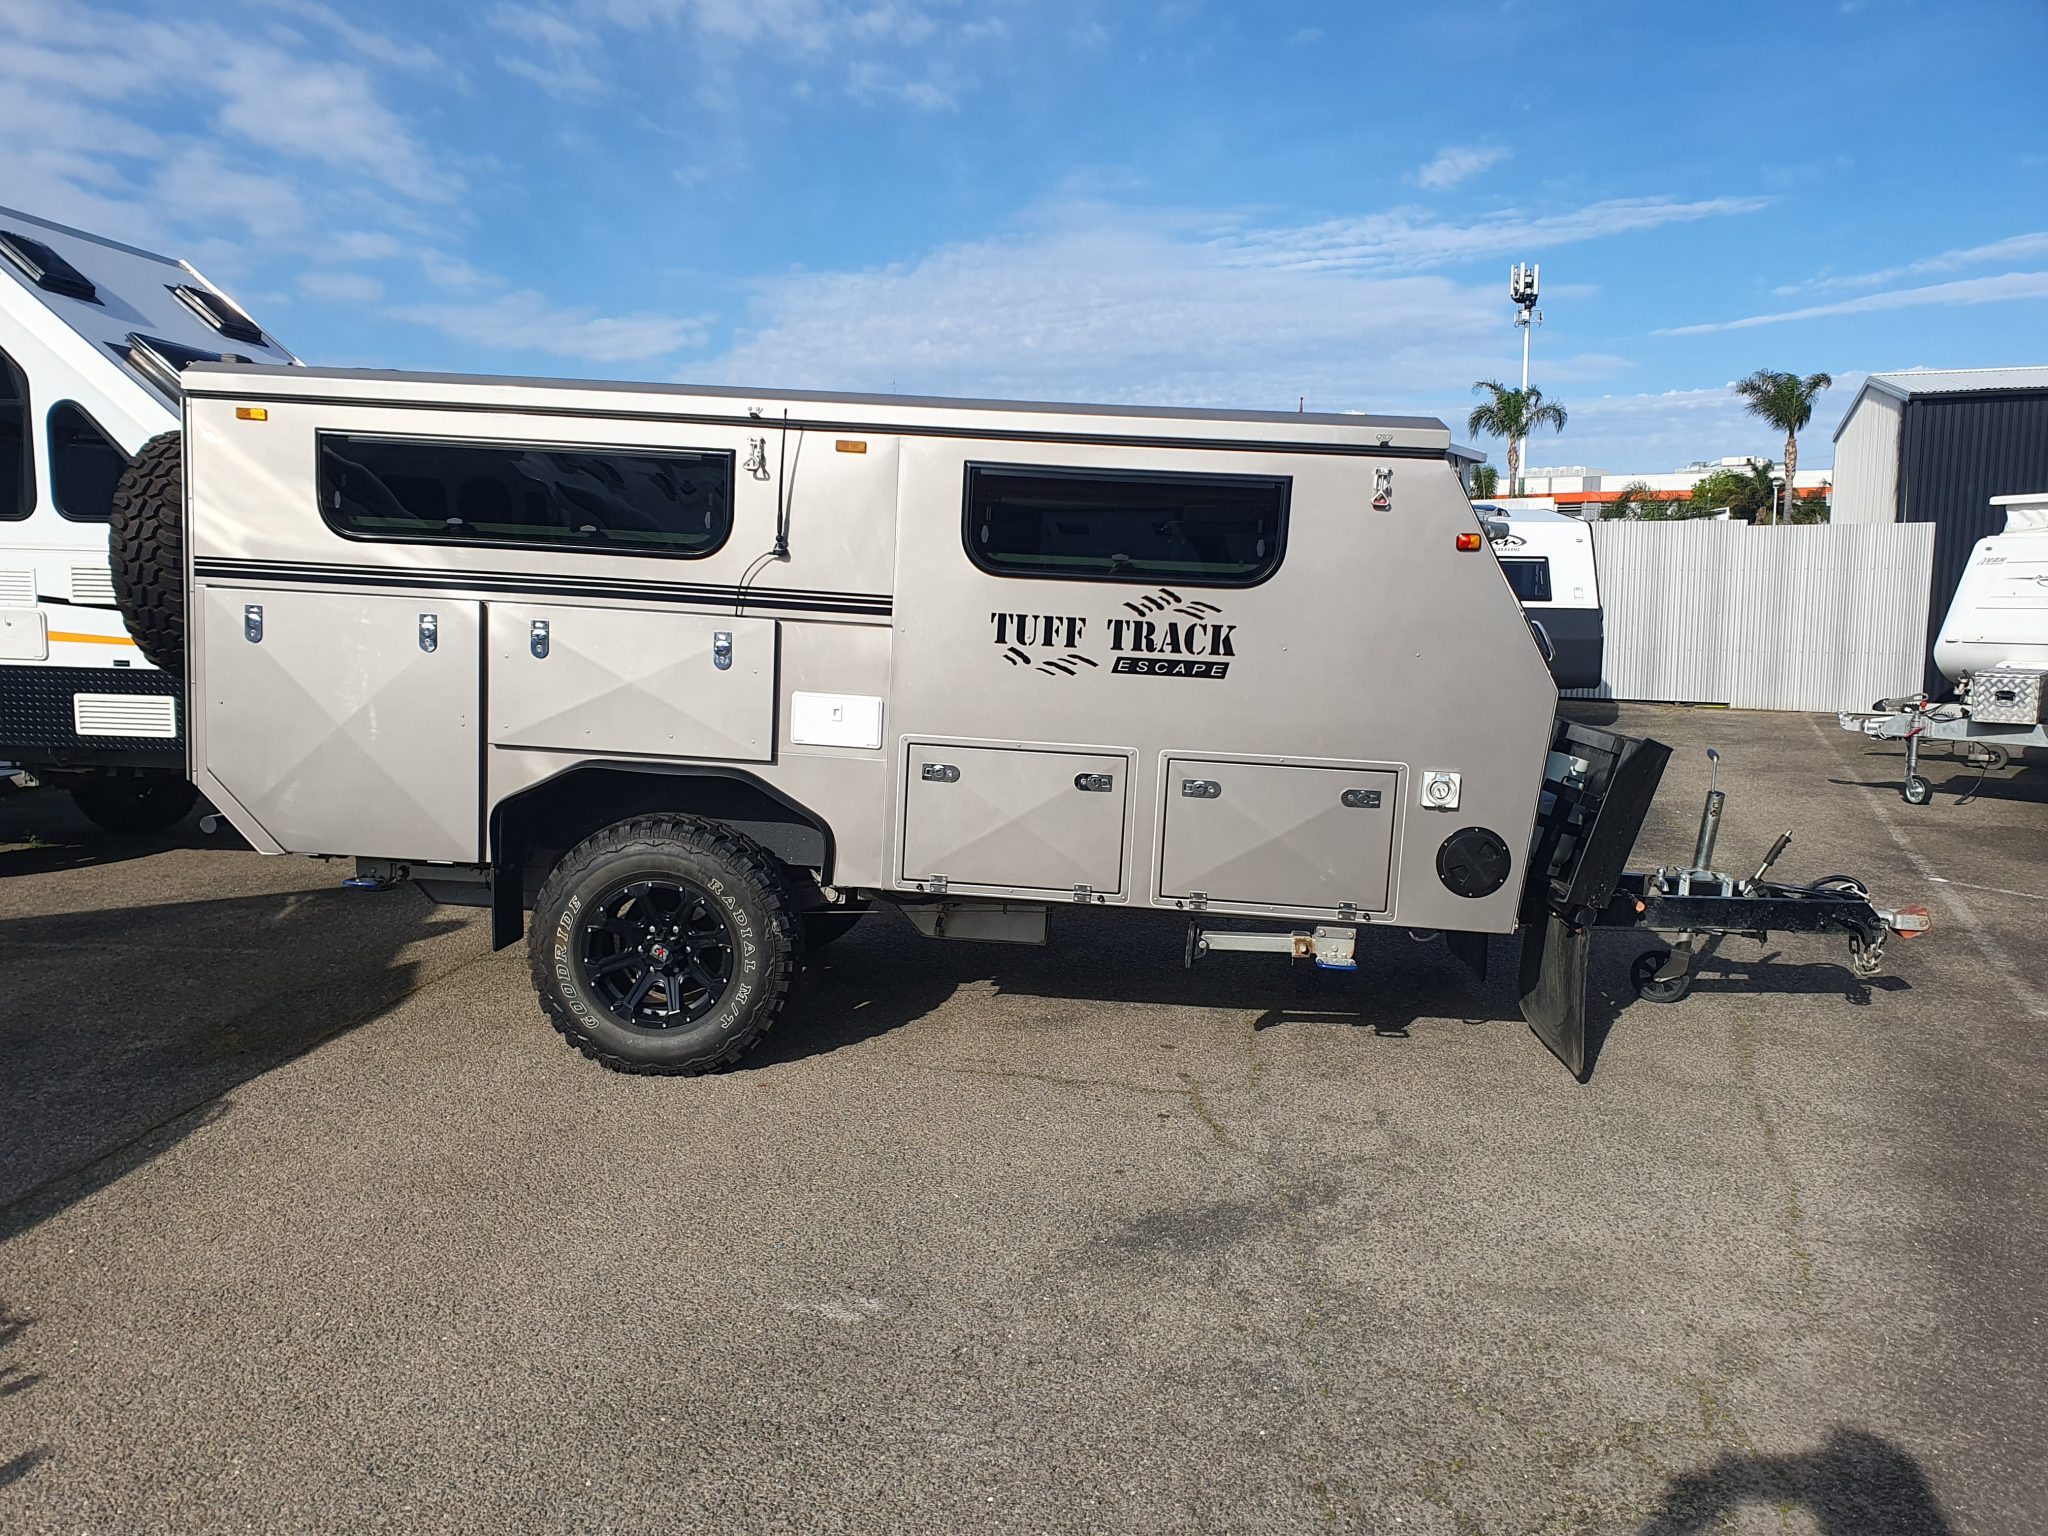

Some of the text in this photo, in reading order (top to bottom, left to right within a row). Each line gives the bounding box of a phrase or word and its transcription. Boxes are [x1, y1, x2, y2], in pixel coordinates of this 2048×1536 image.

[990, 612, 1238, 657] TUFF TRACK
[1116, 659, 1225, 677] ESCAPE
[554, 894, 600, 1030] GOODRIDE
[707, 878, 756, 1030] RADIAL M/T
